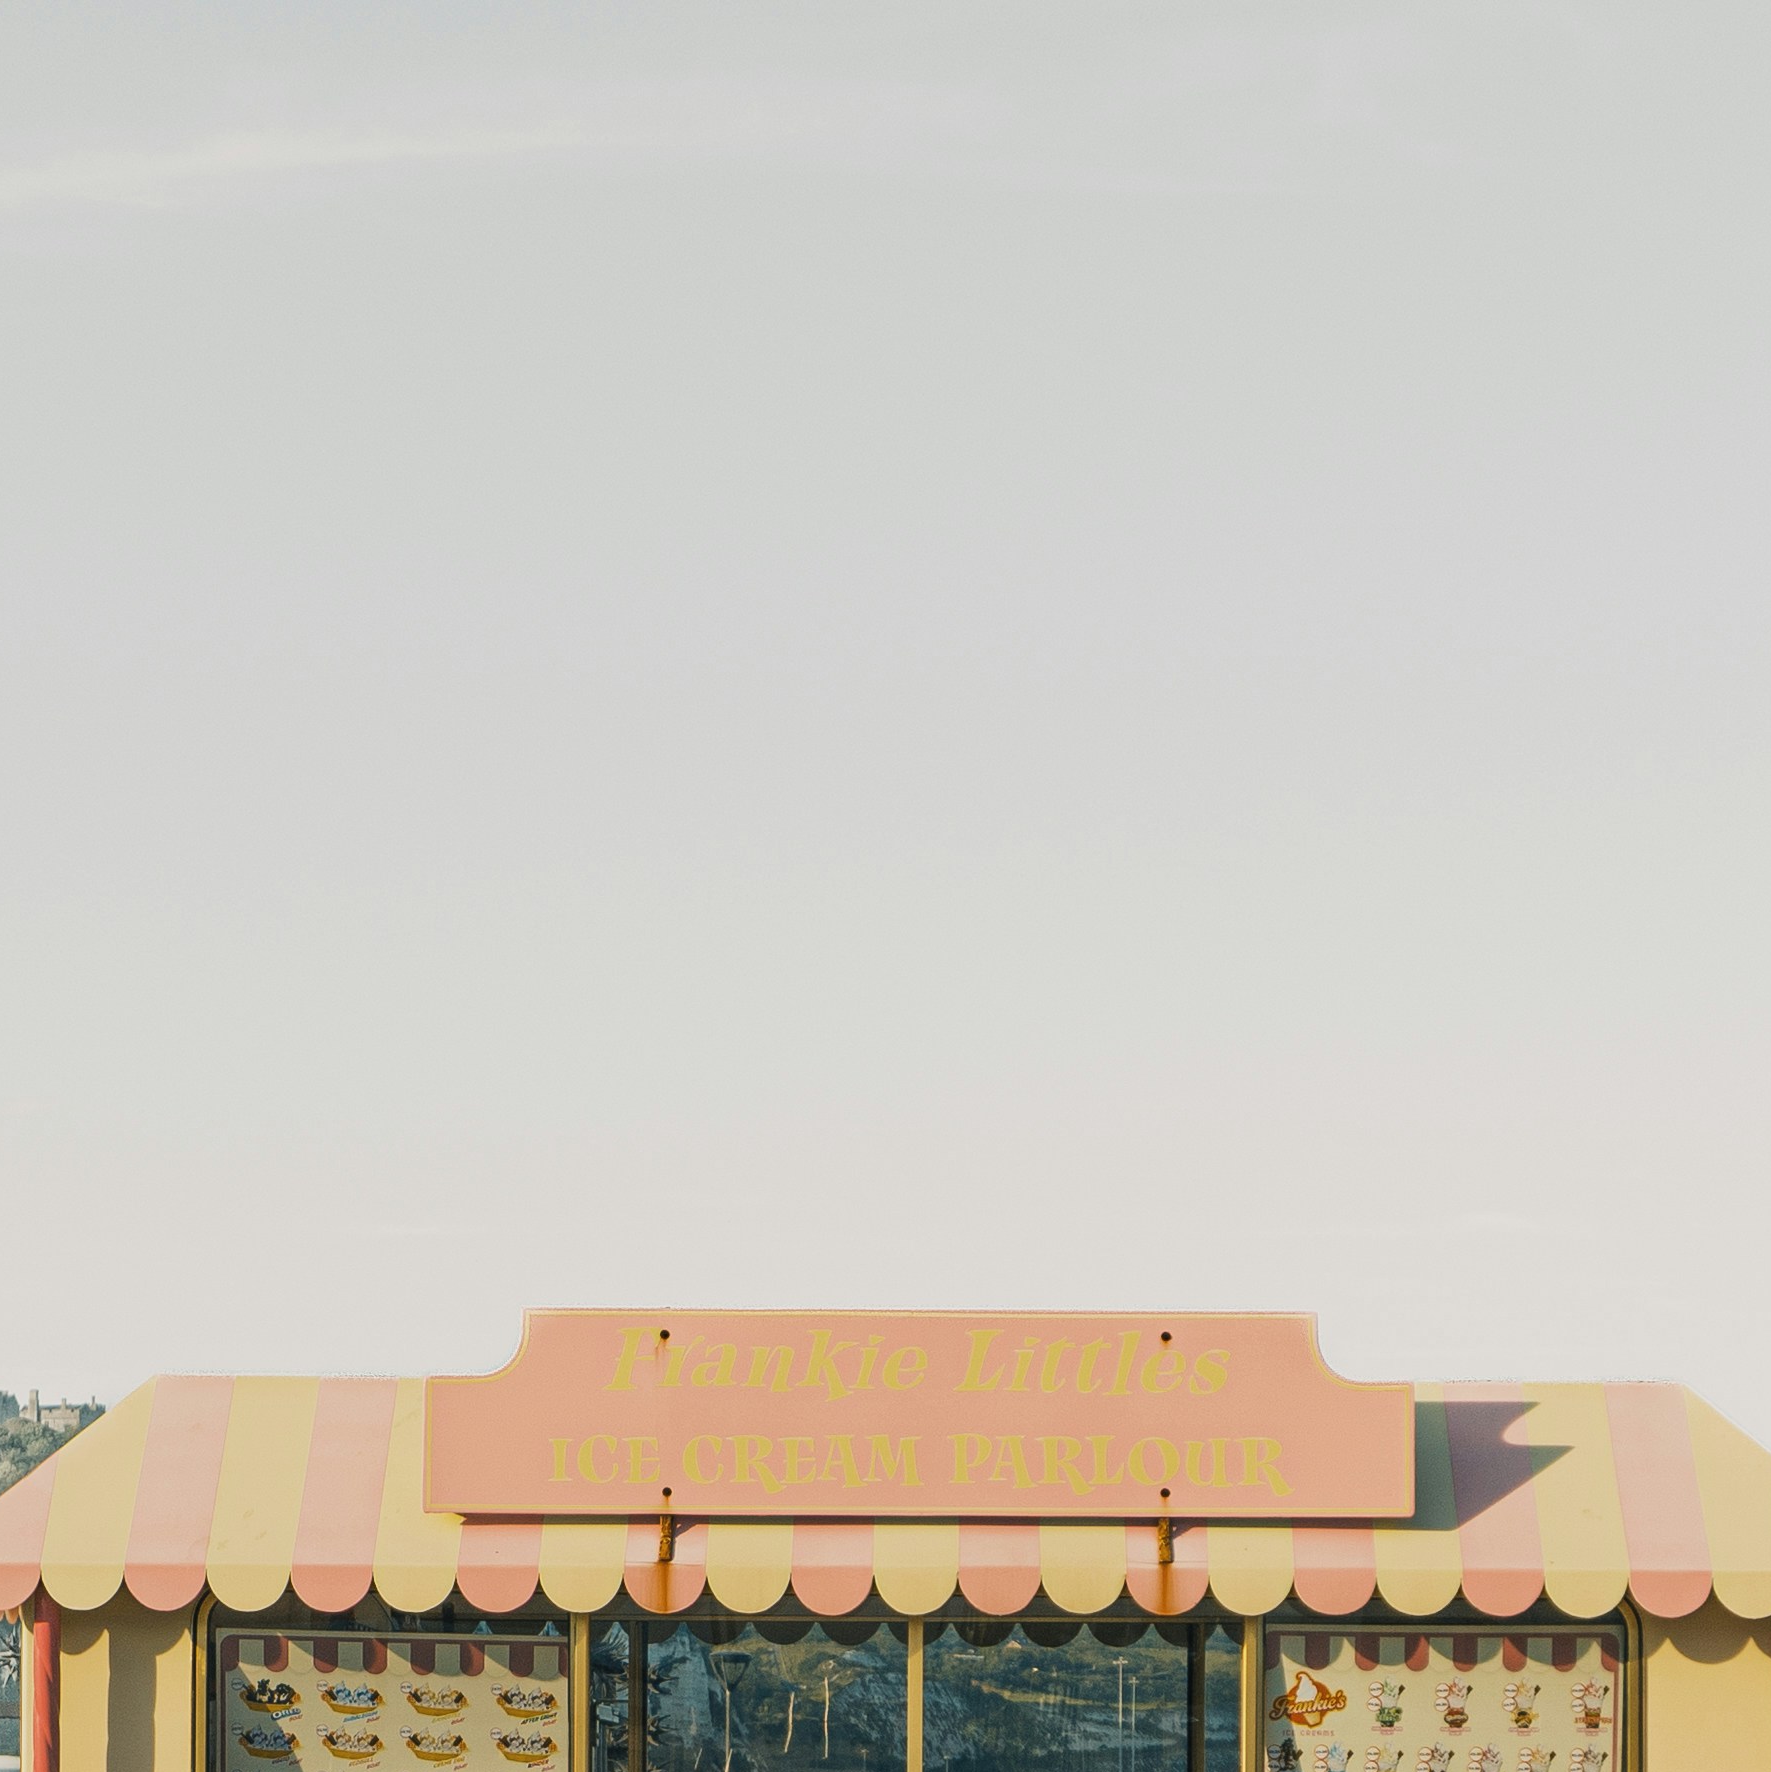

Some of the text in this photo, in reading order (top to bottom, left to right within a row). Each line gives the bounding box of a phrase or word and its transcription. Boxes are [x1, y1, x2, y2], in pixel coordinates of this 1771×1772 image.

[603, 1325, 1231, 1401] Frankie Littles
[548, 1433, 1293, 1497] ICE CREAM PARLOUR
[1269, 1690, 1347, 1720] Frankie's
